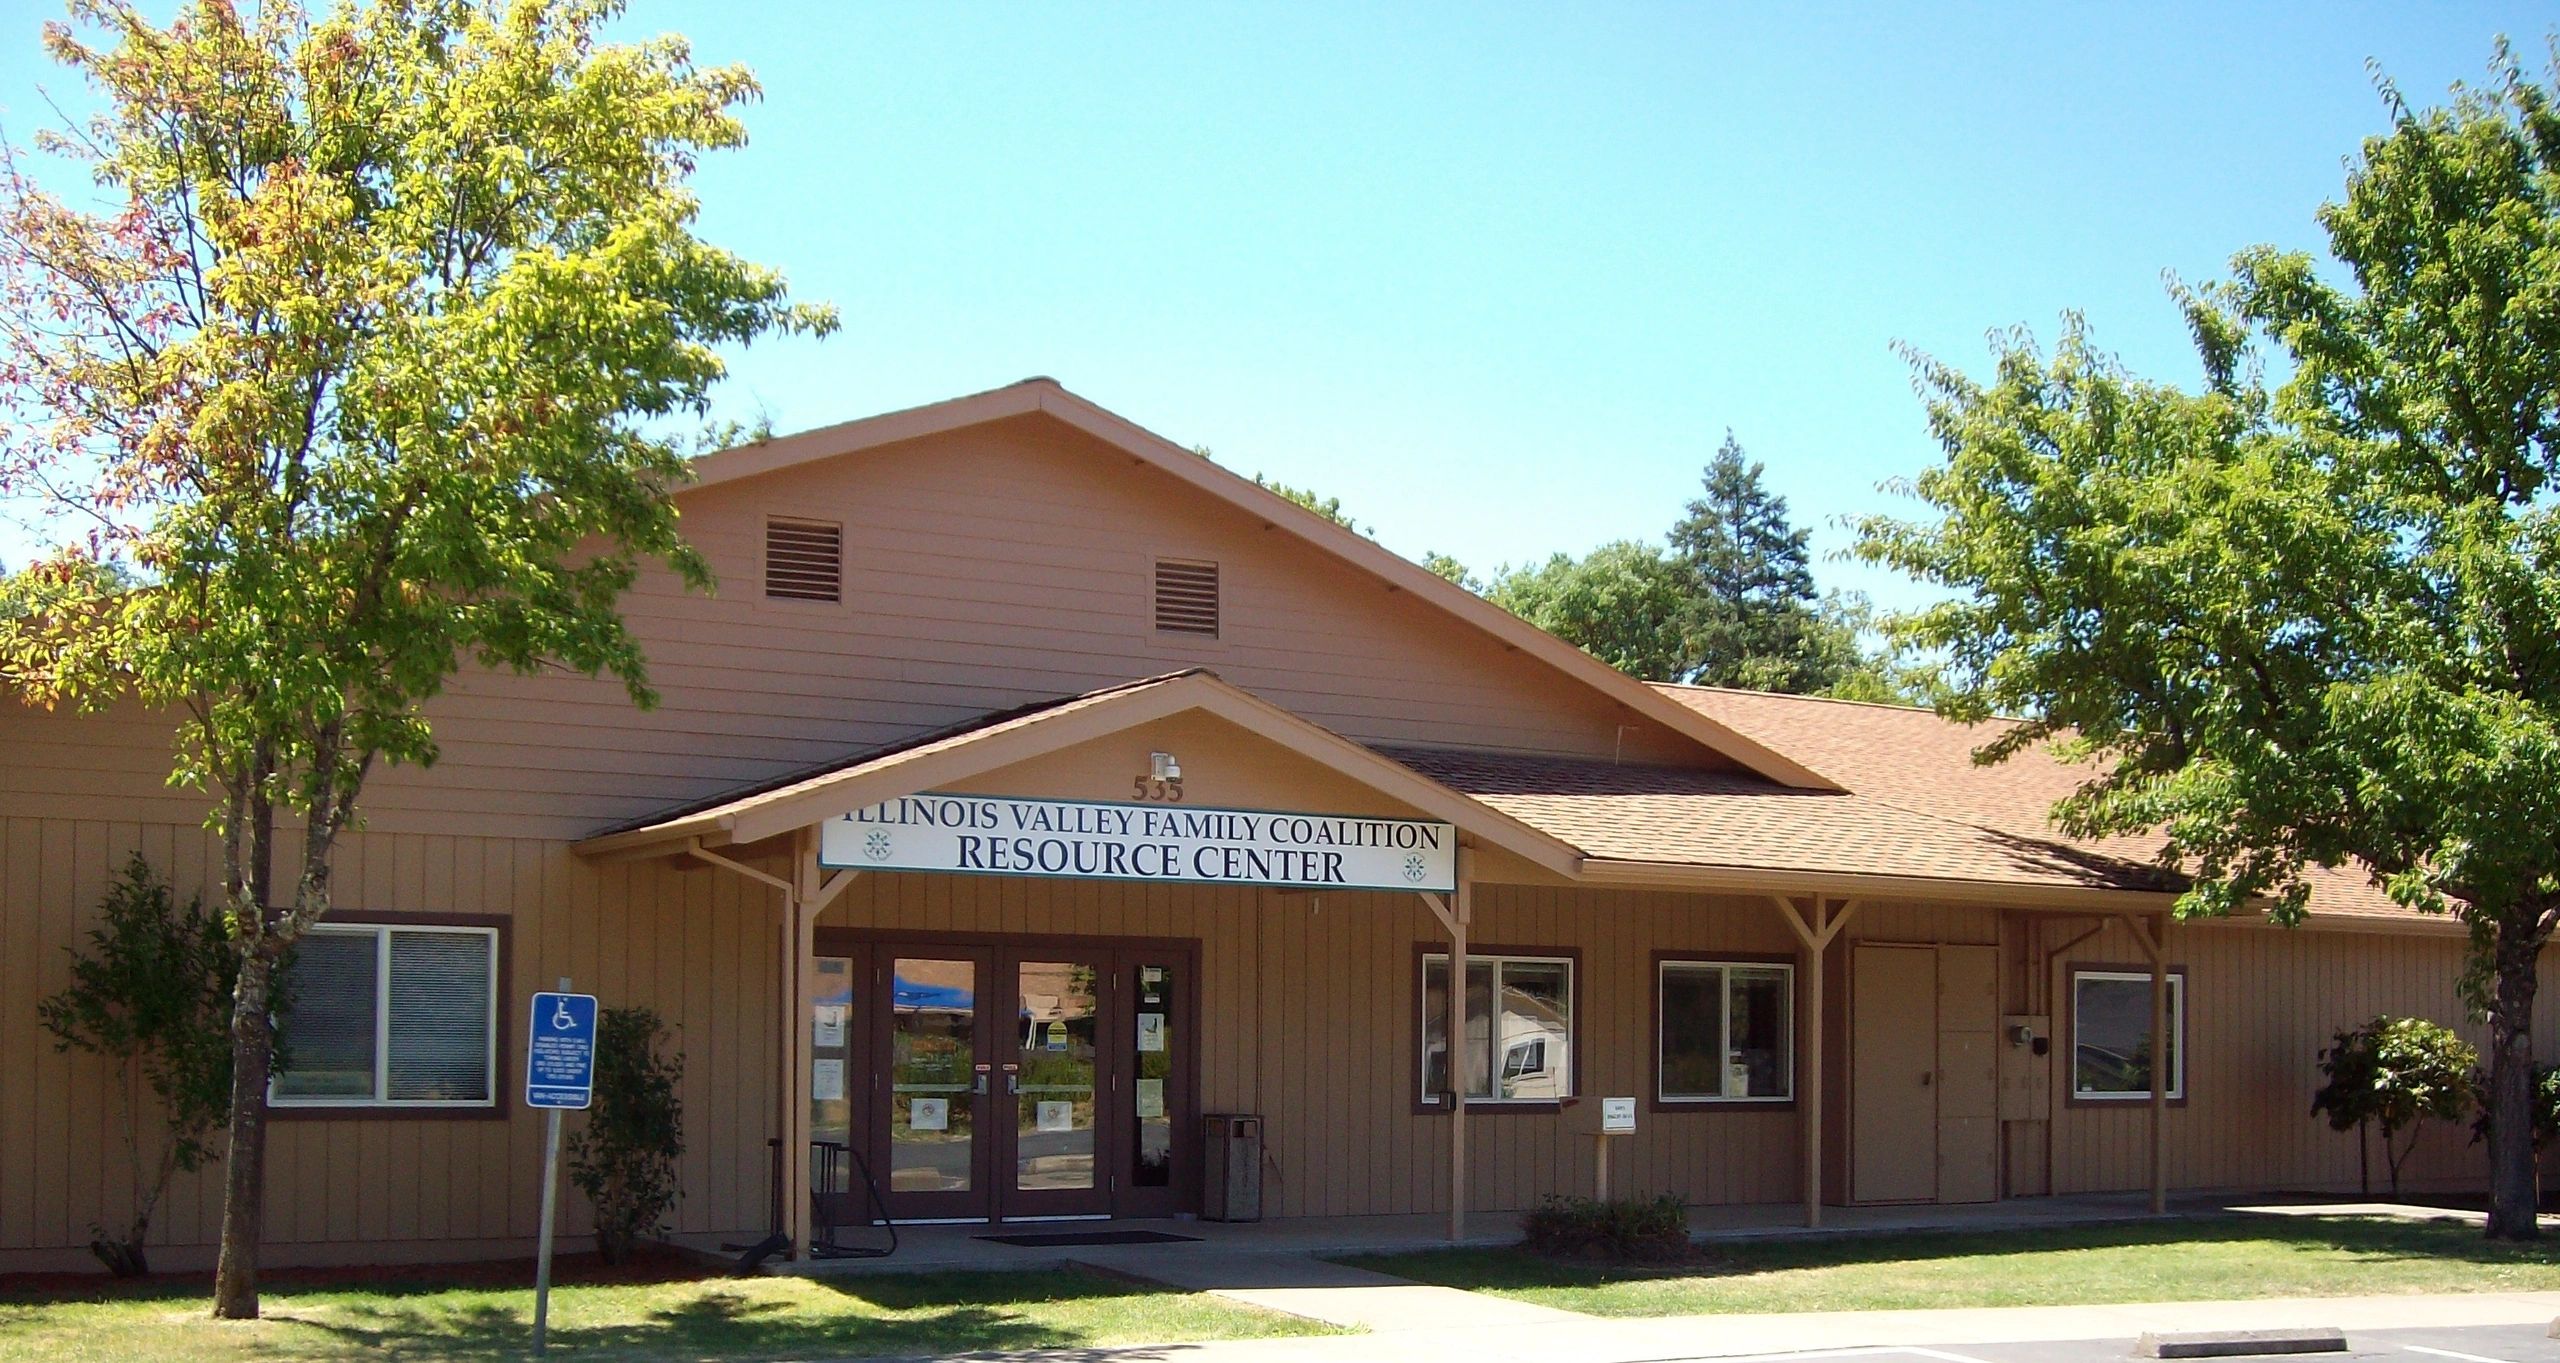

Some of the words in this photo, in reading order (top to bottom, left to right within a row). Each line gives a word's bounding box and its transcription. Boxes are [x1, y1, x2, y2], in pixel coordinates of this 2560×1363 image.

[1131, 776, 1184, 802] 535
[1009, 803, 1134, 835] VALLEY
[1142, 811, 1262, 841] FAMILY
[1269, 818, 1441, 850] COALITION
[957, 835, 1181, 876] RESOURCE
[1193, 846, 1346, 883] CENTER
